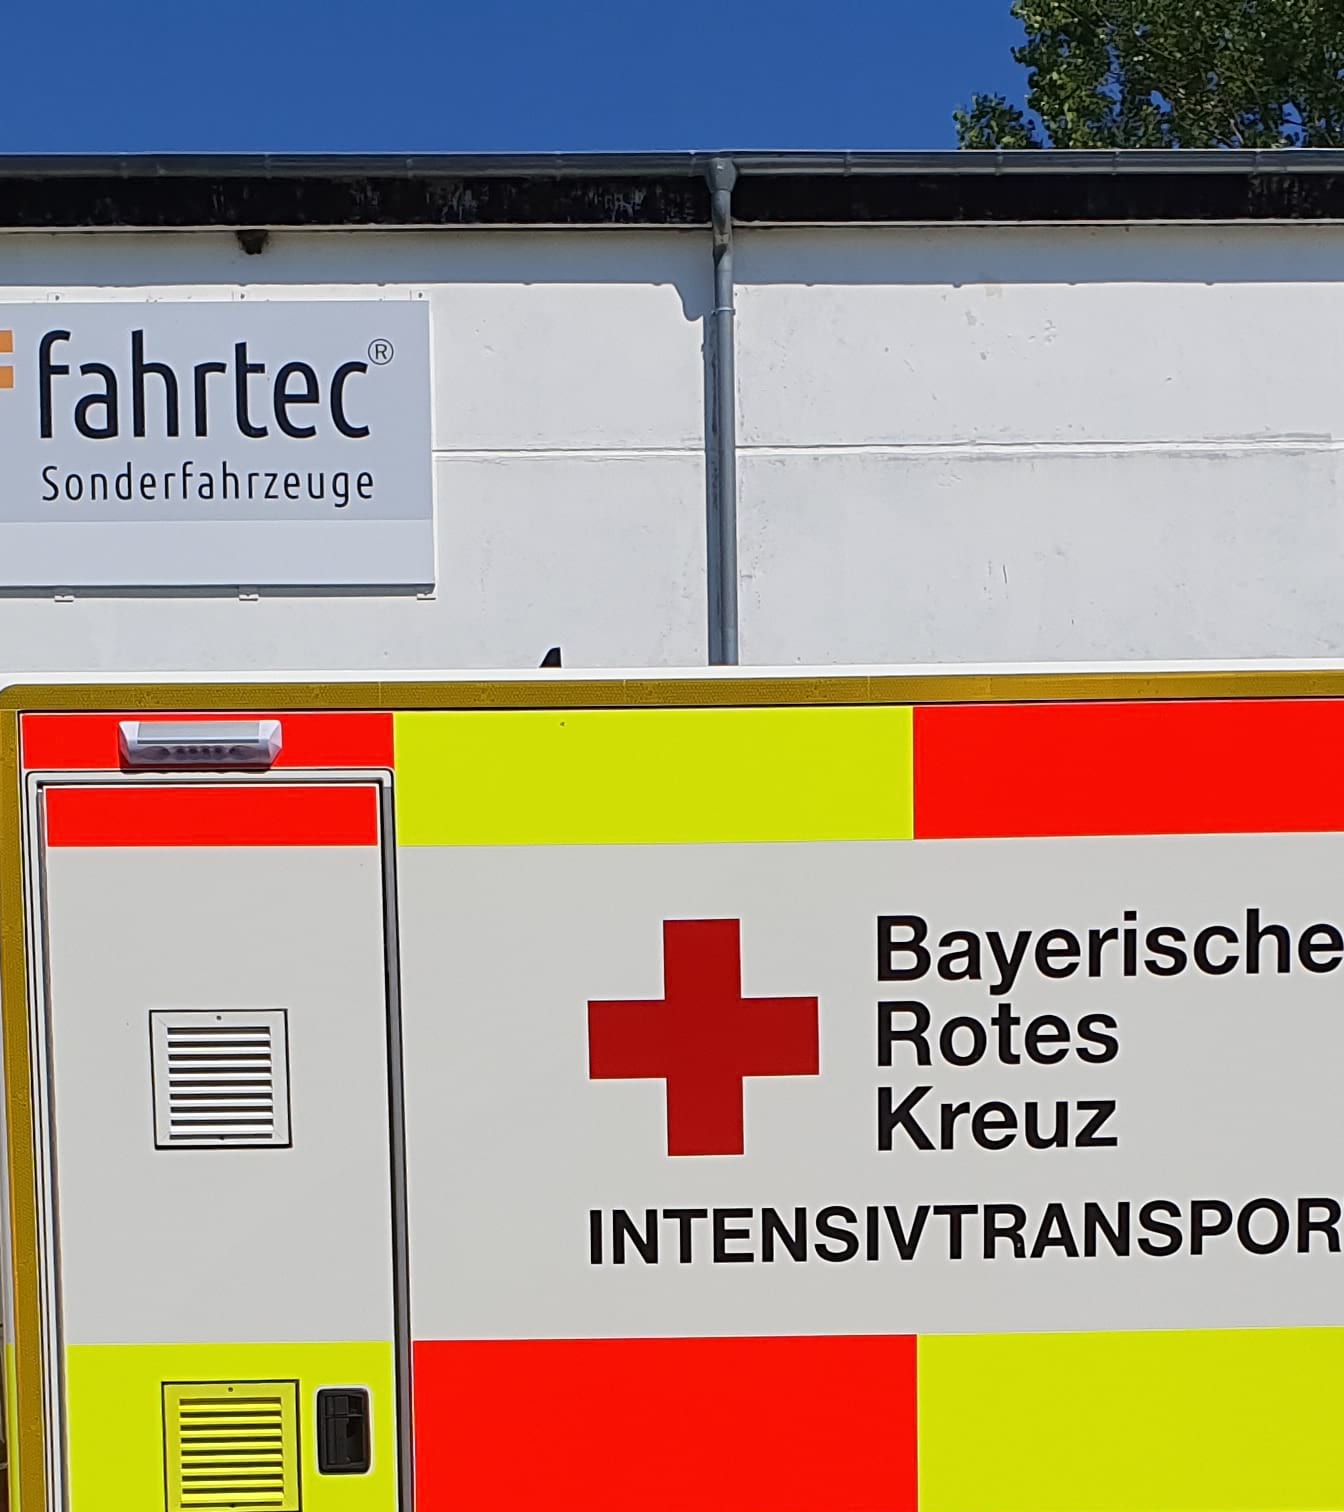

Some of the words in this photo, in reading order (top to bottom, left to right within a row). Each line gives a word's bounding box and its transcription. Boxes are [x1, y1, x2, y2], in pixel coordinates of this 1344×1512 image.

[41, 461, 374, 508] Sonderfahrzeuge
[876, 1000, 1120, 1067] Rotes
[876, 1085, 1119, 1151] Kreuz
